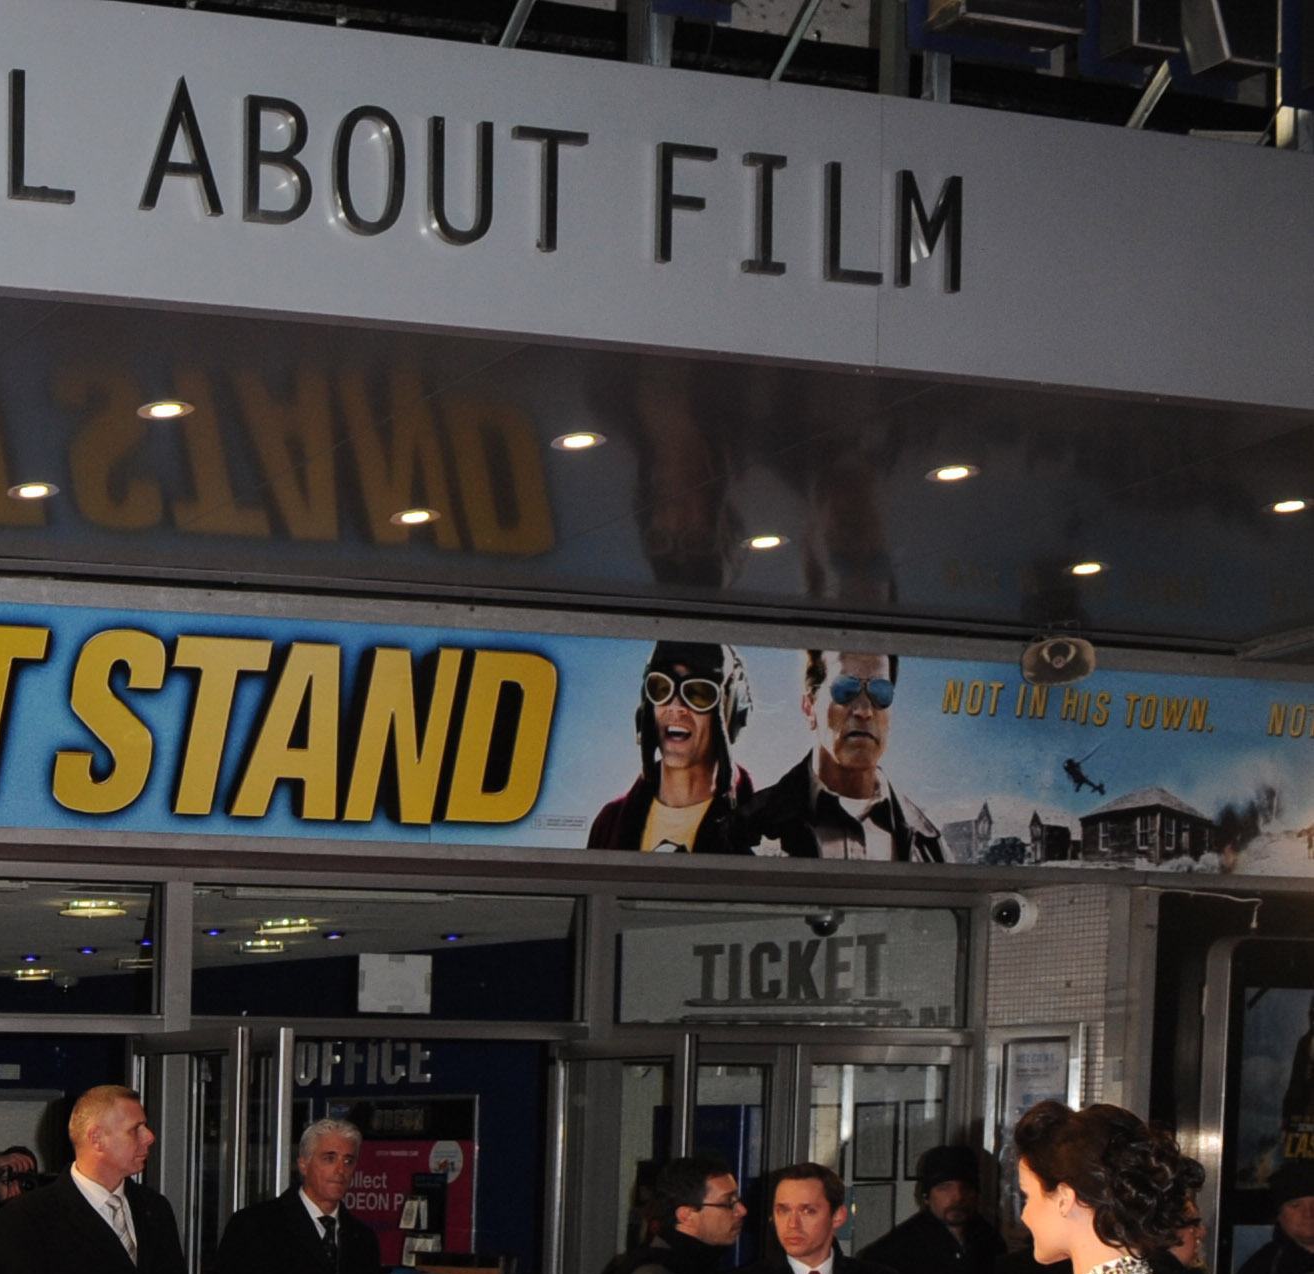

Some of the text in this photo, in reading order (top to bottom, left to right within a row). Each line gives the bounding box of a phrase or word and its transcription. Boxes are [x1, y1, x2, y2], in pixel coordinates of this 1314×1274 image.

[139, 73, 588, 254] ABOUT
[653, 141, 963, 294] FILM
[53, 628, 559, 825] STAND
[941, 679, 1006, 718] NOT
[1015, 682, 1053, 721] IN
[1061, 686, 1111, 728] HIS
[1125, 695, 1215, 734] TOWN.
[692, 932, 887, 1001] TICKET
[294, 1041, 432, 1087] OFFICE
[1283, 1131, 1314, 1160] LAS
[350, 1171, 388, 1190] llect
